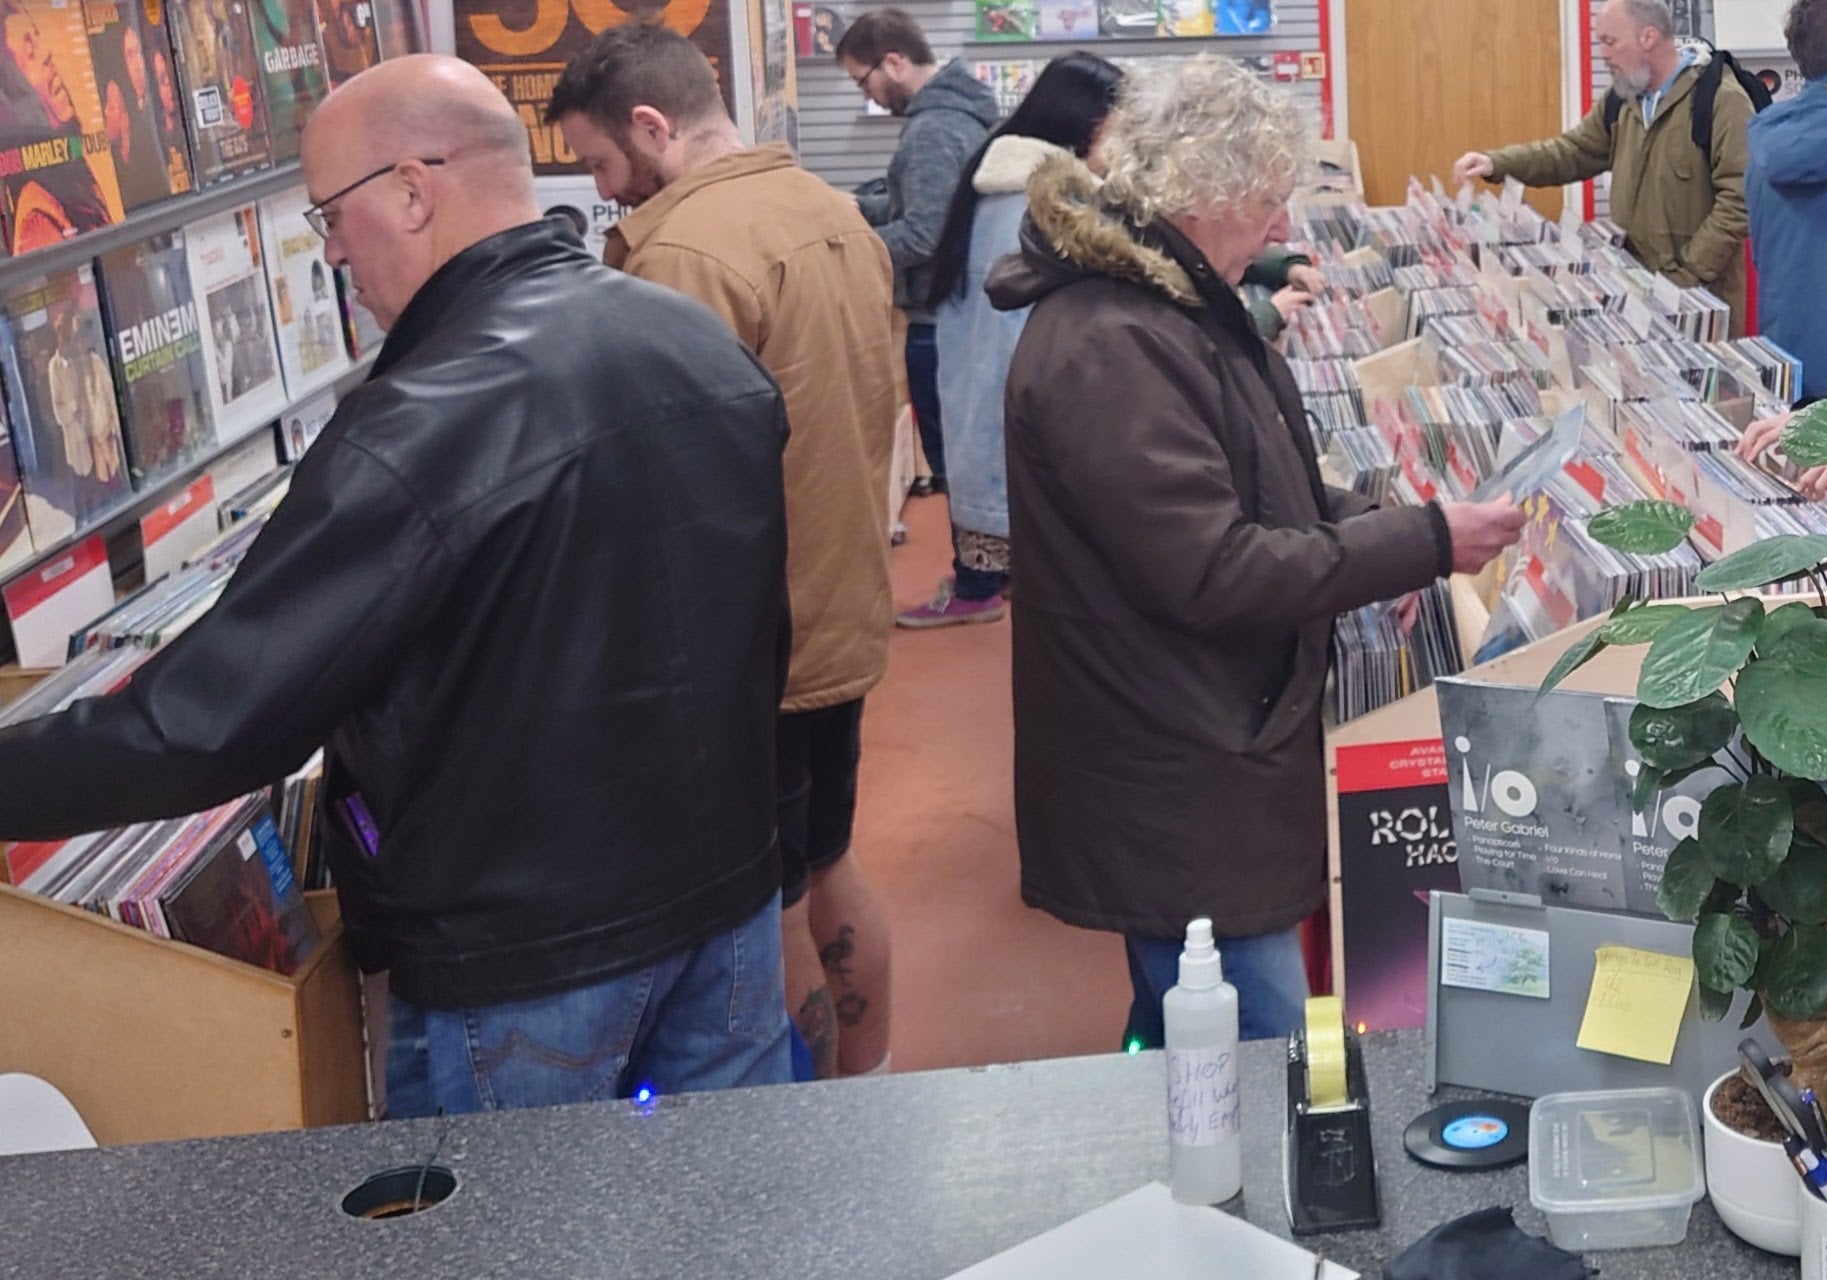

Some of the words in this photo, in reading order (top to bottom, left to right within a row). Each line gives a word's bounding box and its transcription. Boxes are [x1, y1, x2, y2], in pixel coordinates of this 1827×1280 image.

[264, 43, 320, 74] GARBAGE
[21, 137, 69, 172] MARLEY
[119, 301, 197, 365] EMINEM
[1369, 806, 1450, 845] ROL
[1464, 815, 1498, 832] Peter
[1500, 821, 1550, 838] Gabriel
[1632, 840, 1670, 859] Peter
